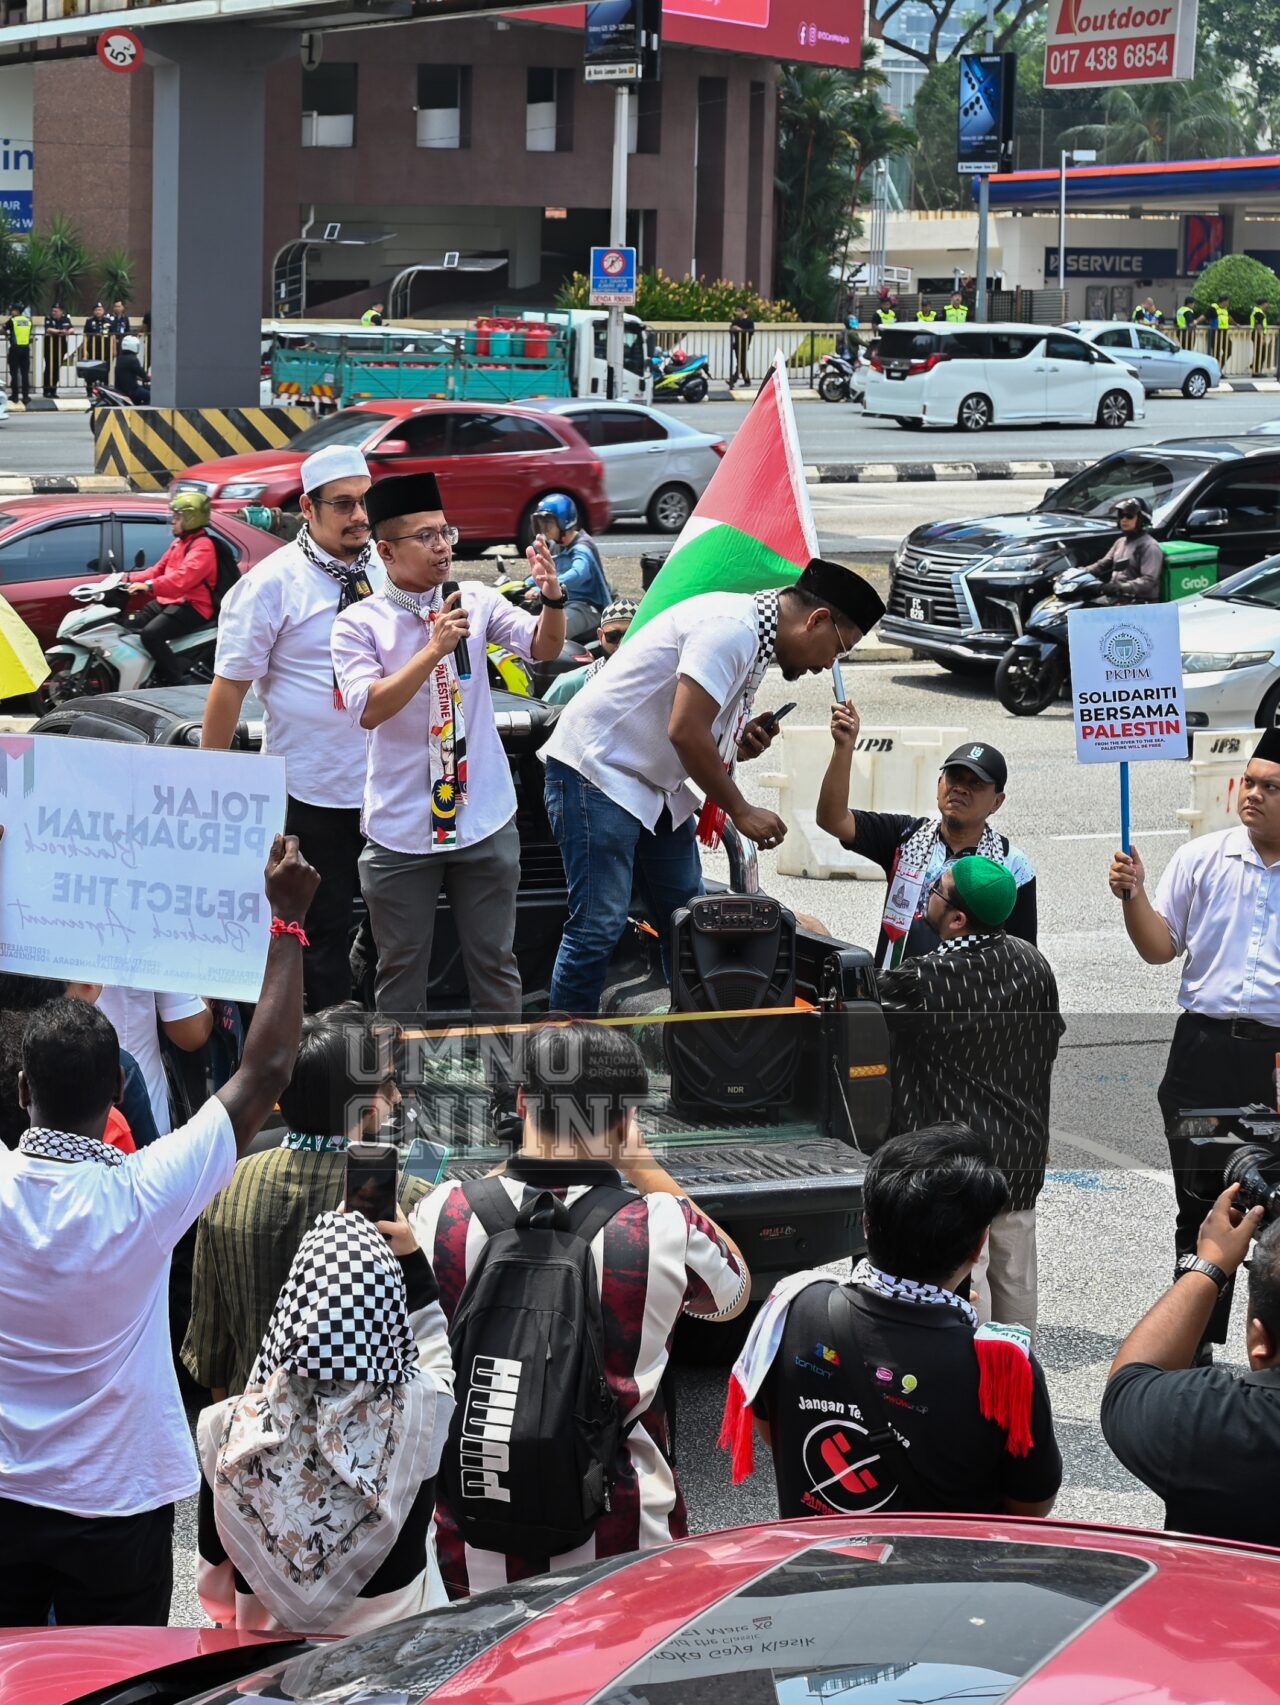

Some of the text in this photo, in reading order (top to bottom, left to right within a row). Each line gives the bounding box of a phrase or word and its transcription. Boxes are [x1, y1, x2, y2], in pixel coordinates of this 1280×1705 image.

[1078, 6, 1172, 33] outdoor
[1050, 41, 1168, 75] 017 438 6854
[1066, 254, 1143, 272] SERVICE
[1180, 576, 1210, 591] Grab
[1105, 668, 1151, 681] PKPIM
[435, 663, 451, 719] PALESTINE
[1078, 687, 1177, 704] SOLIDARITI
[1080, 703, 1179, 722] BERSAMA
[1081, 720, 1181, 740] PALESTIN
[727, 1086, 745, 1094] NDR
[798, 1396, 845, 1414] Jangan
[459, 1354, 523, 1503] PUMA
